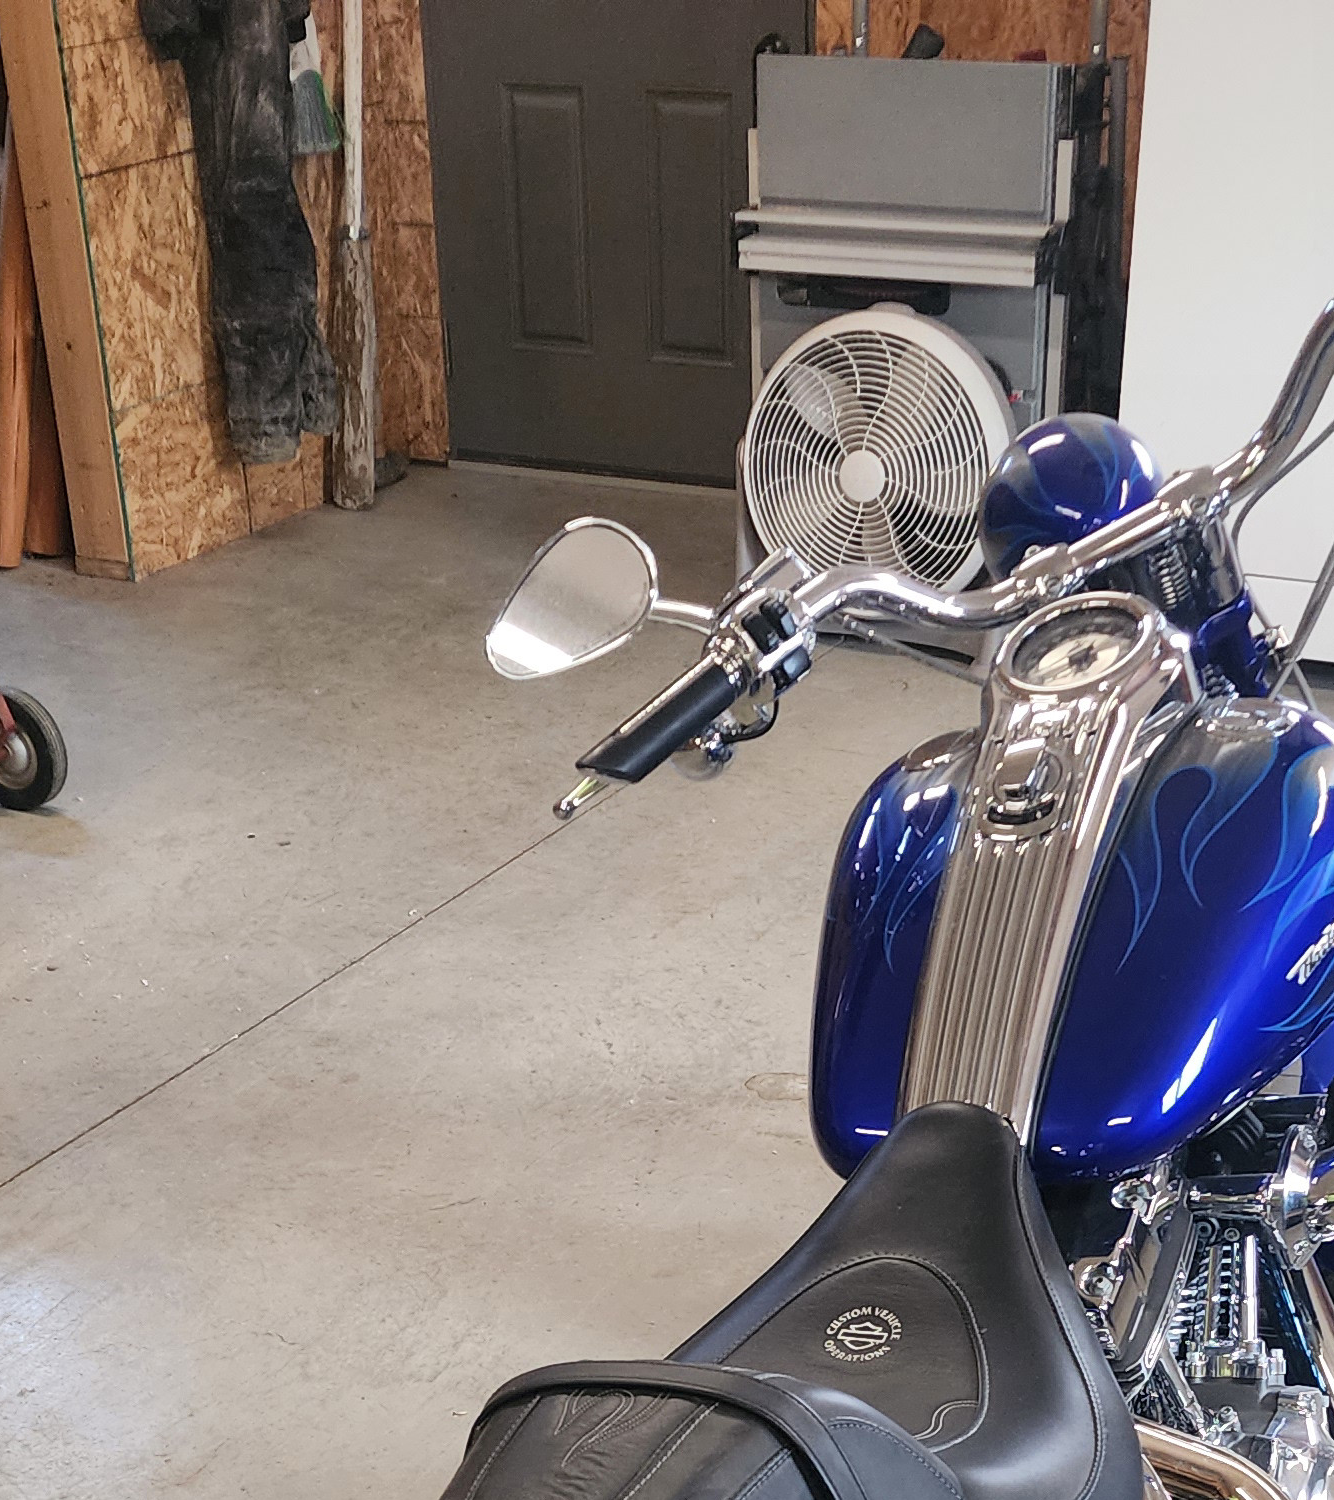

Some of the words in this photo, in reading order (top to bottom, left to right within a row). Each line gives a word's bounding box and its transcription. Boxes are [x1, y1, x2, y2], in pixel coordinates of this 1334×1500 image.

[826, 1306, 873, 1336] CUSTOM
[873, 1307, 903, 1341] VEHICLE
[823, 1339, 892, 1362] OPERATIONS
